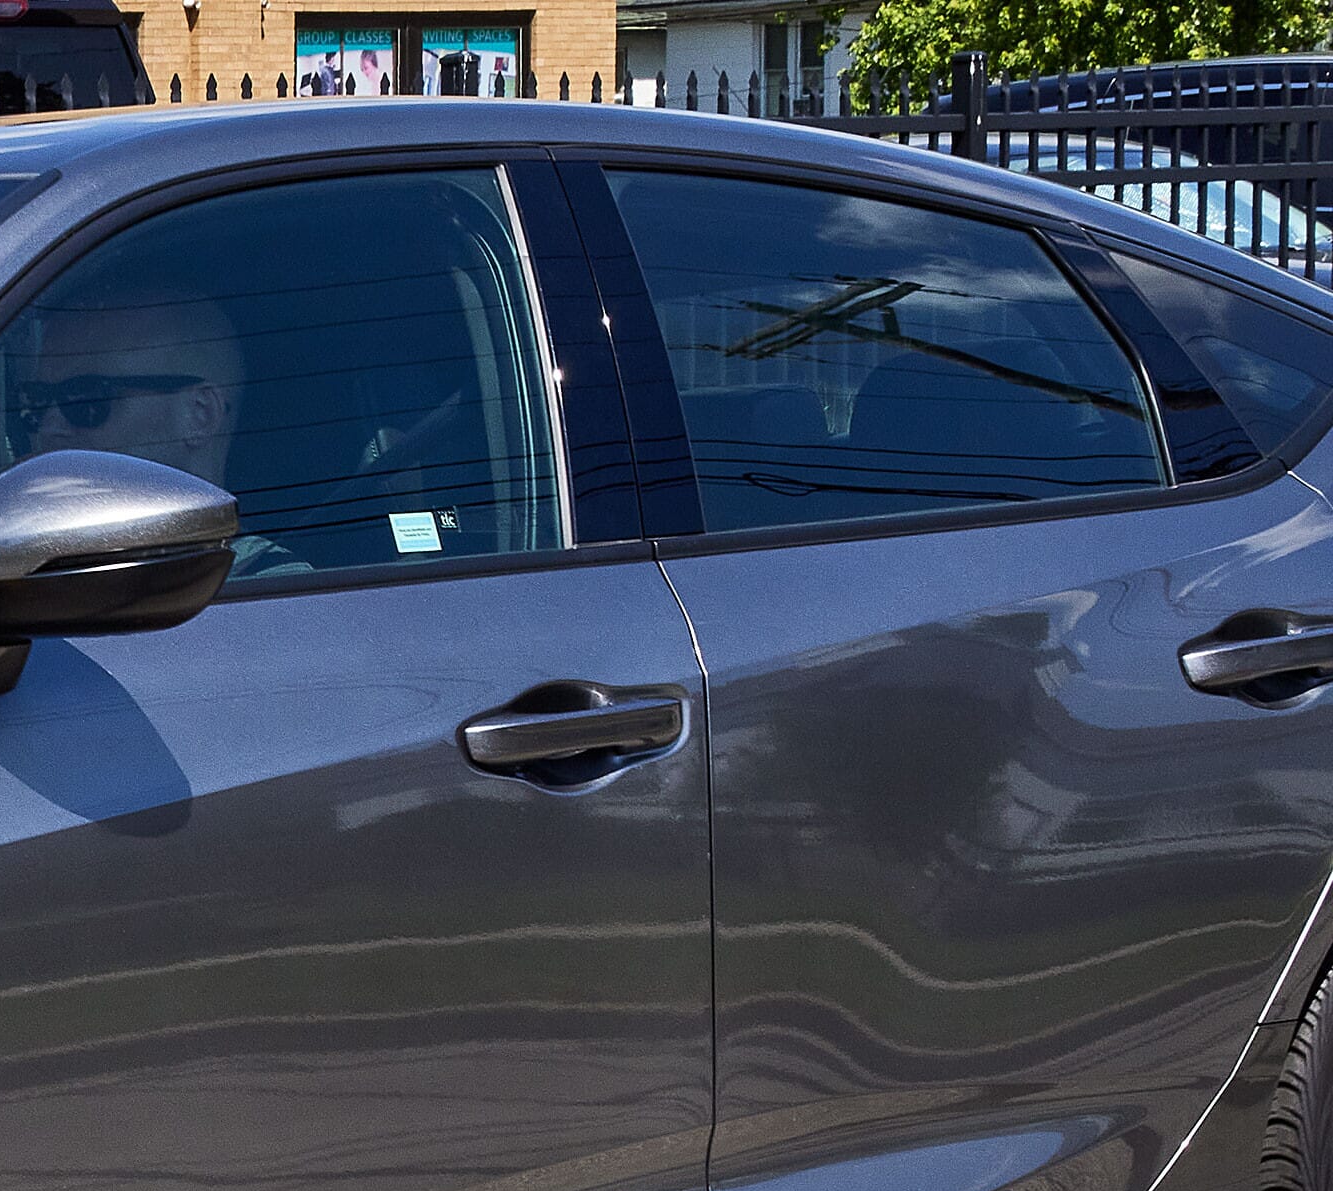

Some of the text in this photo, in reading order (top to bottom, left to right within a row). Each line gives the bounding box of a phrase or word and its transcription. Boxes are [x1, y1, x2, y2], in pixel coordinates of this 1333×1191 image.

[297, 31, 392, 43] GROUP CLASSES
[422, 30, 511, 42] NVITING SPACES
